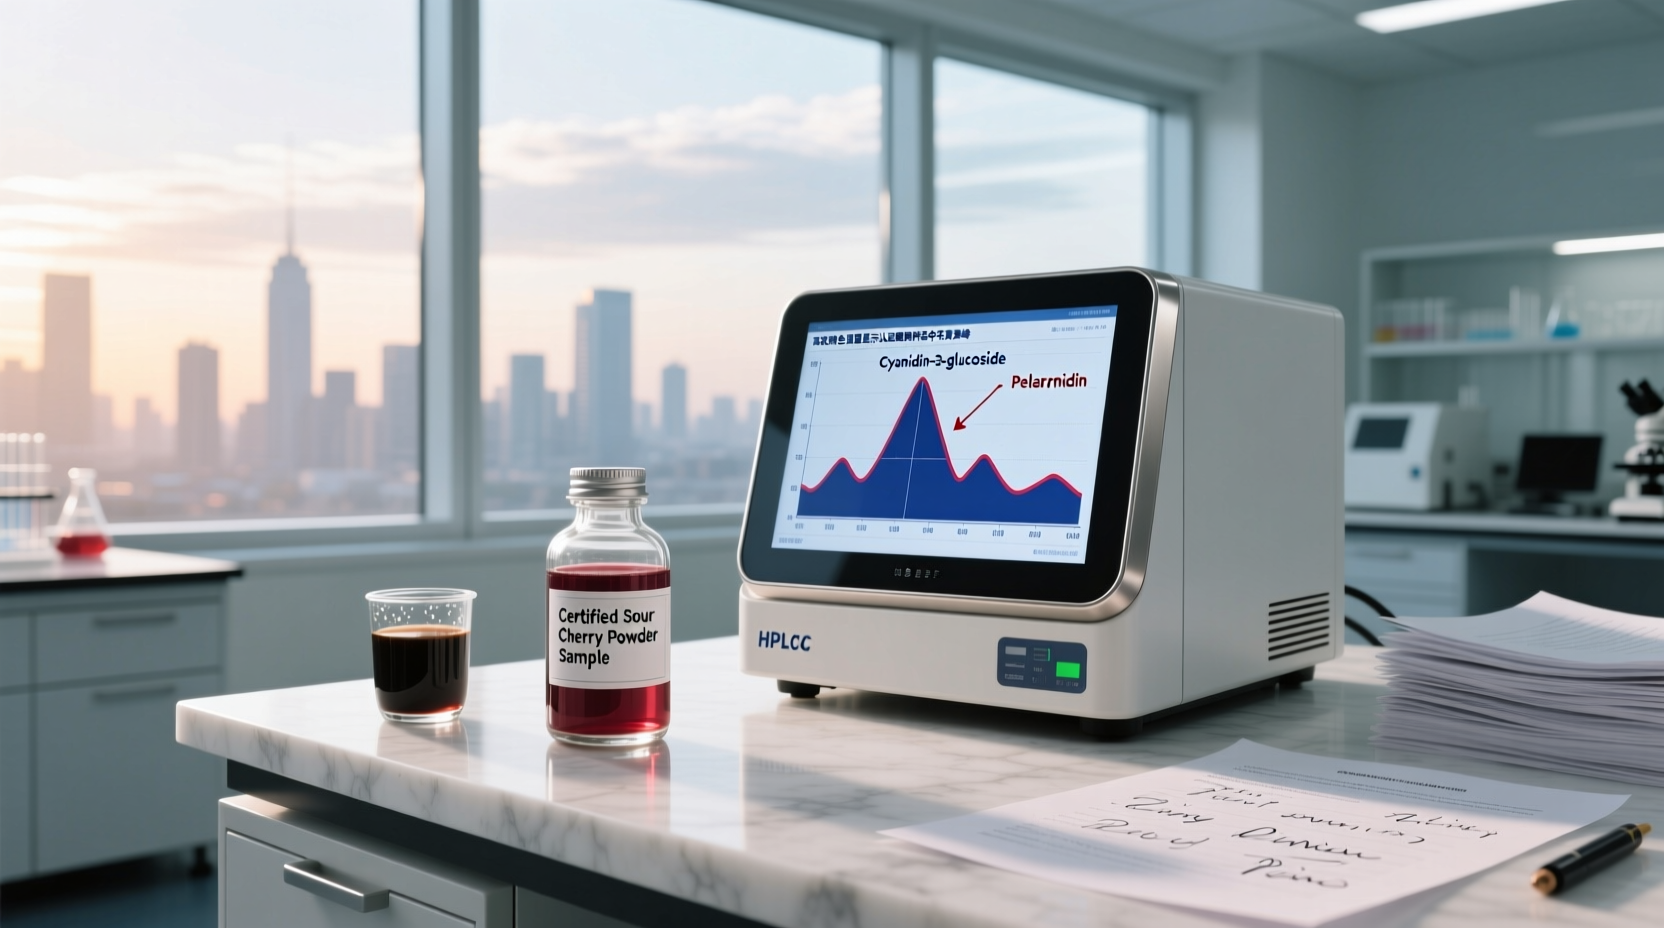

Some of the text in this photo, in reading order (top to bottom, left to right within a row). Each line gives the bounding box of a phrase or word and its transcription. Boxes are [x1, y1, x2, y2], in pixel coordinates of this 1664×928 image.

[879, 350, 1006, 372] Cyanidin-3-glucoside
[558, 607, 655, 624] Certified Sour
[558, 627, 658, 648] Cherry Powder
[758, 630, 812, 652] HPLCC
[559, 648, 610, 670] Sample
